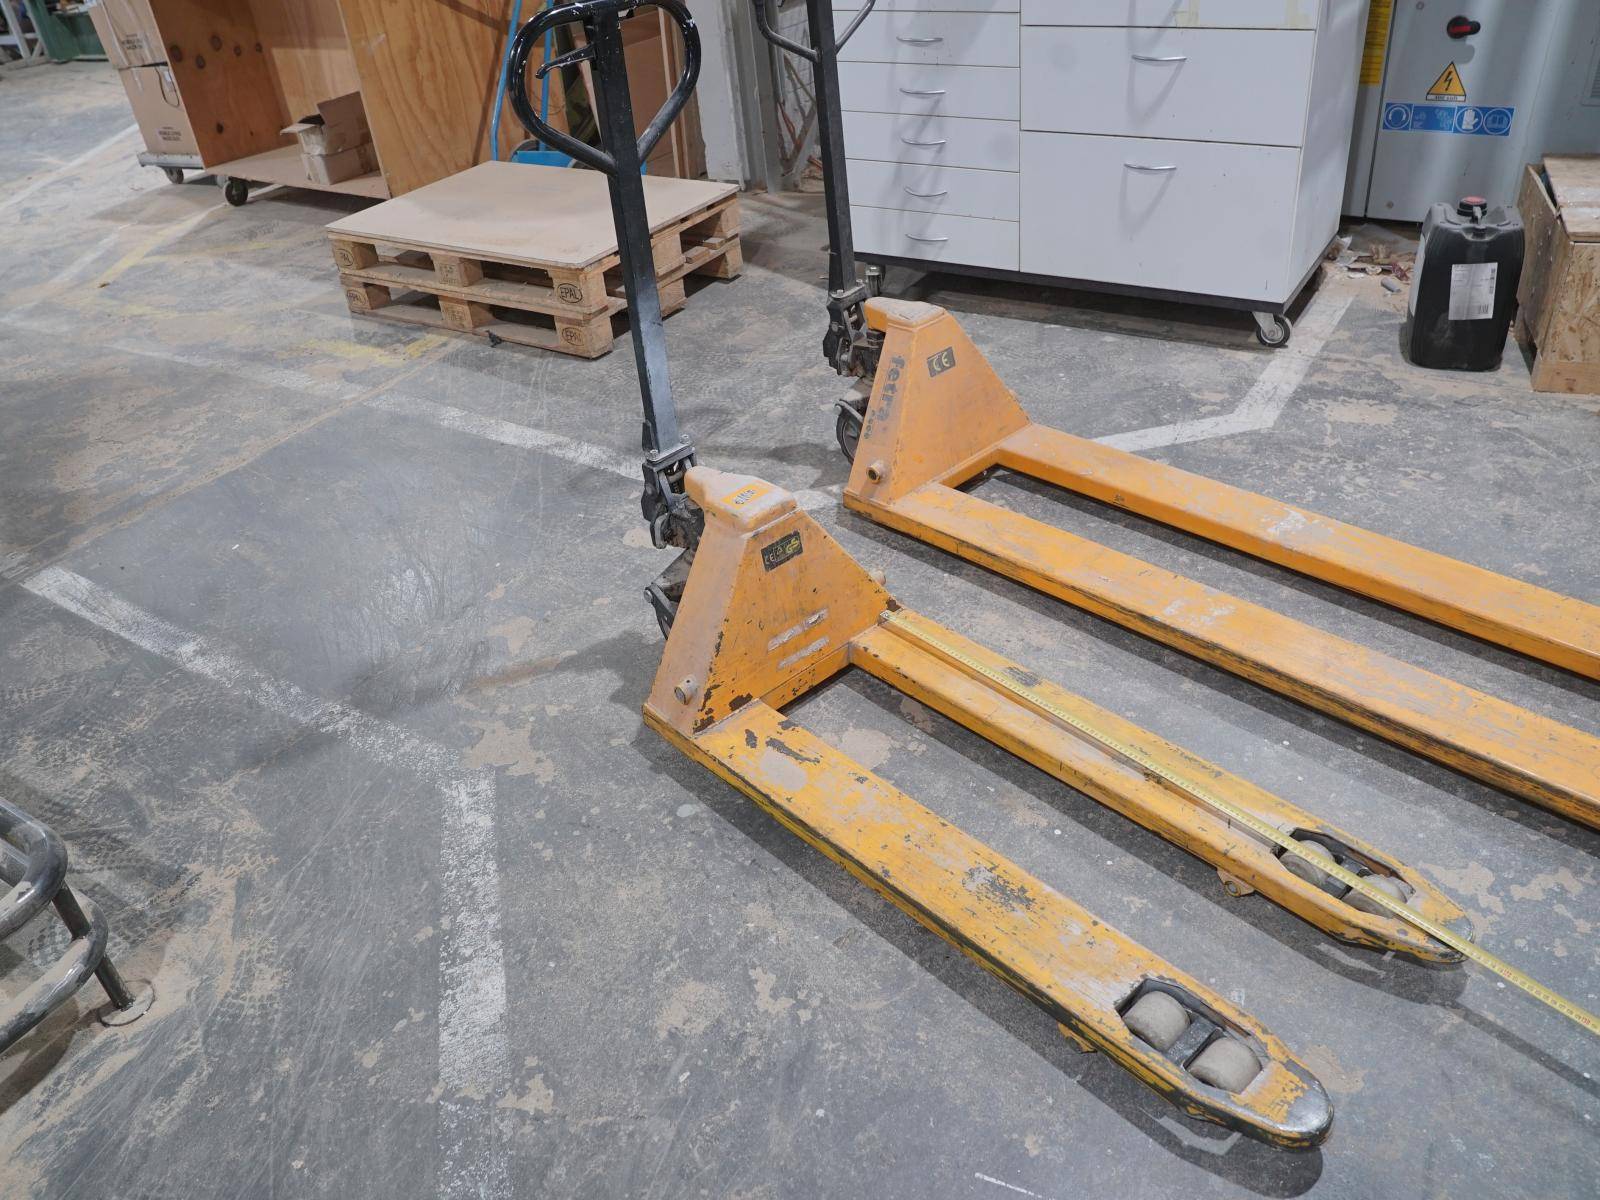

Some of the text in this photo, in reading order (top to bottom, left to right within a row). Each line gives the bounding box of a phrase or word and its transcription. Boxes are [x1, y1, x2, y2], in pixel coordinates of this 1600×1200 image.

[559, 286, 580, 301] EPAL
[933, 351, 951, 371] CE
[877, 355, 905, 421] fetra
